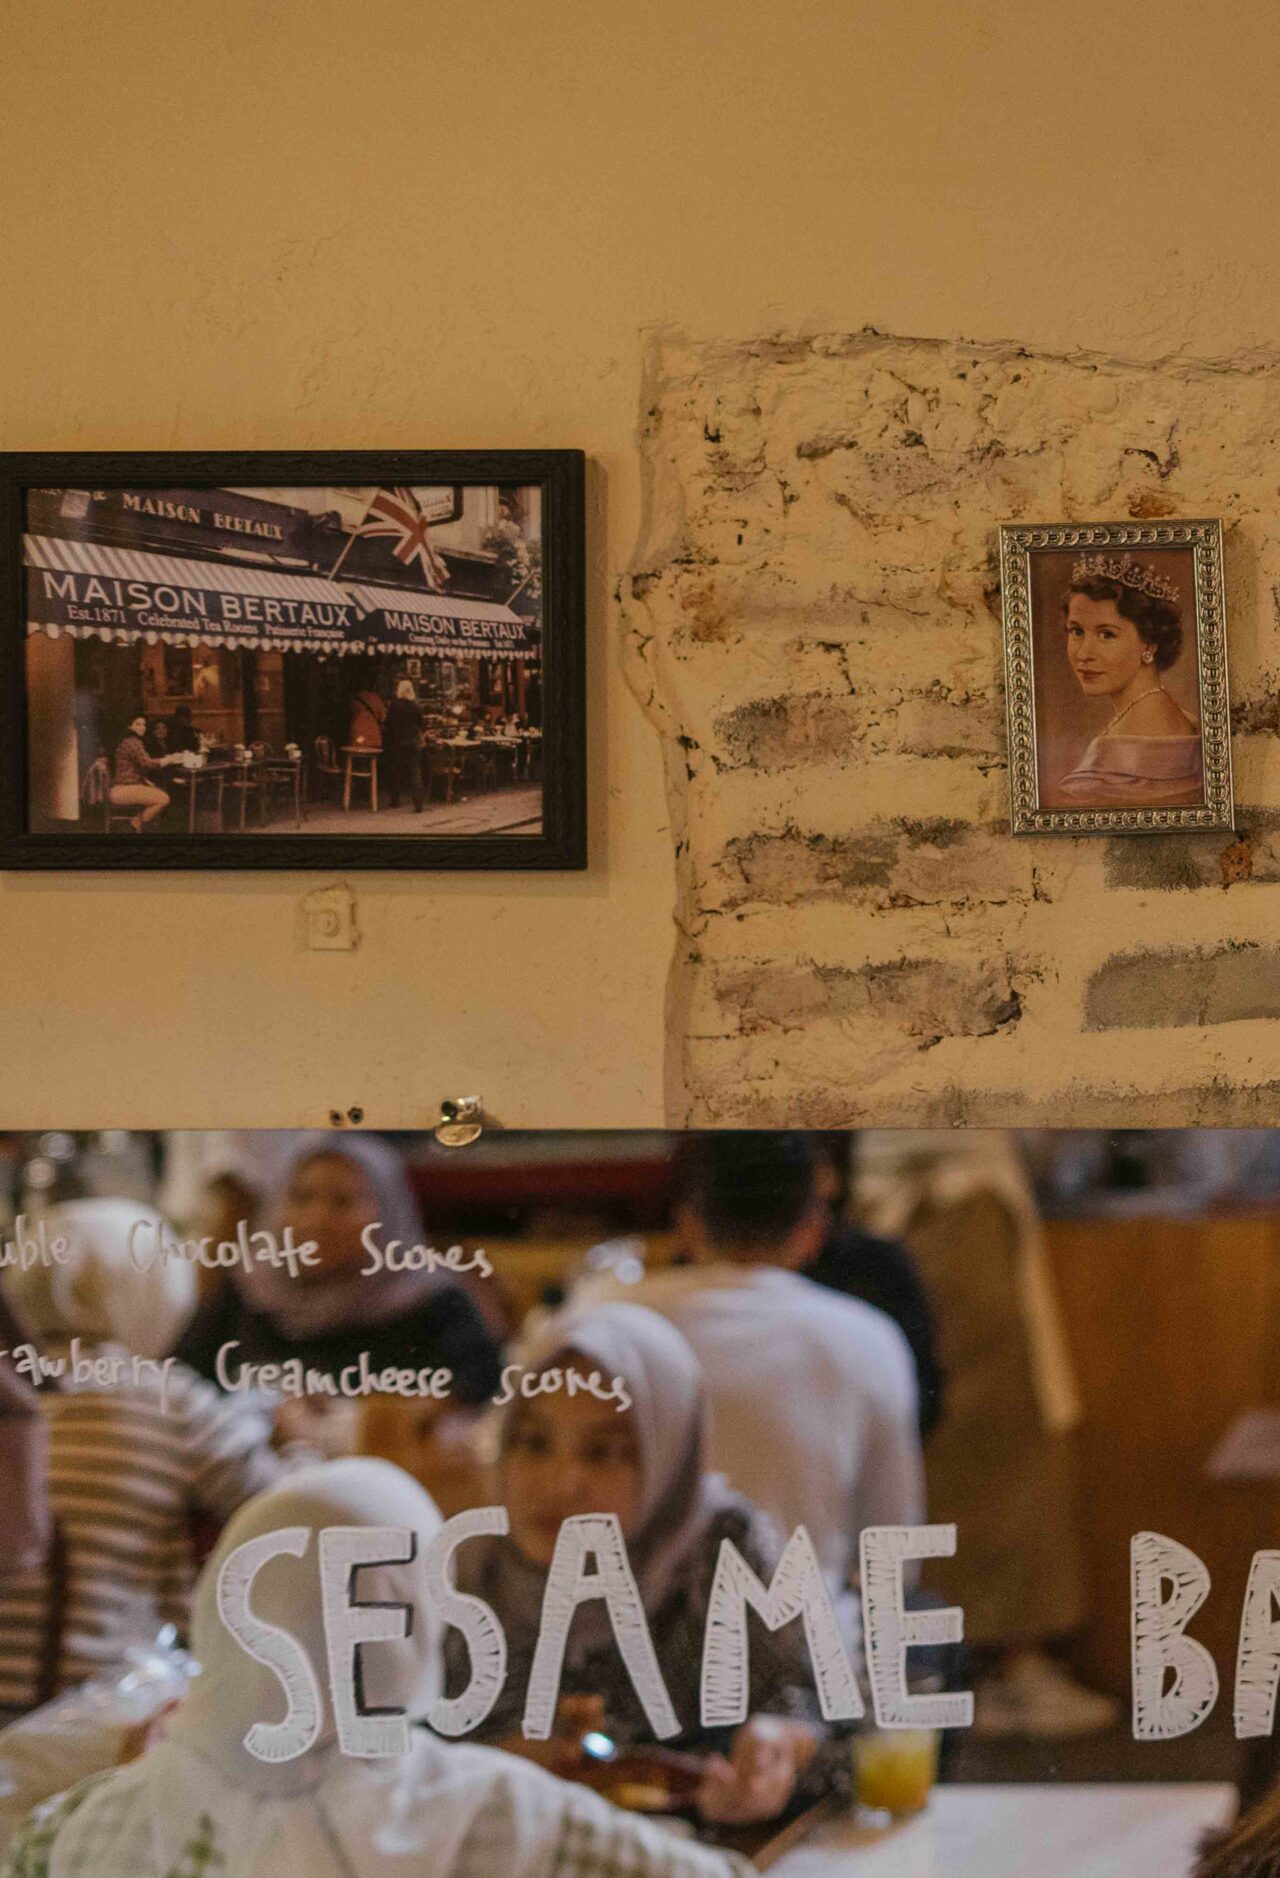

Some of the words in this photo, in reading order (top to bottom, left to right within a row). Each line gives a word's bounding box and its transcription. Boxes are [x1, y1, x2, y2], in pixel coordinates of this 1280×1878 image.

[121, 492, 200, 524] MAISON
[213, 512, 283, 541] BERTAUX
[42, 571, 208, 616] MAISON
[220, 594, 351, 627] BERTAUX
[383, 610, 456, 637] MAISON
[460, 619, 527, 640] BERTAUX
[128, 1219, 322, 1279] Chocolate
[360, 1222, 494, 1279] Scones
[215, 1340, 453, 1399] Creamcheese
[215, 1505, 975, 1763] SESAME
